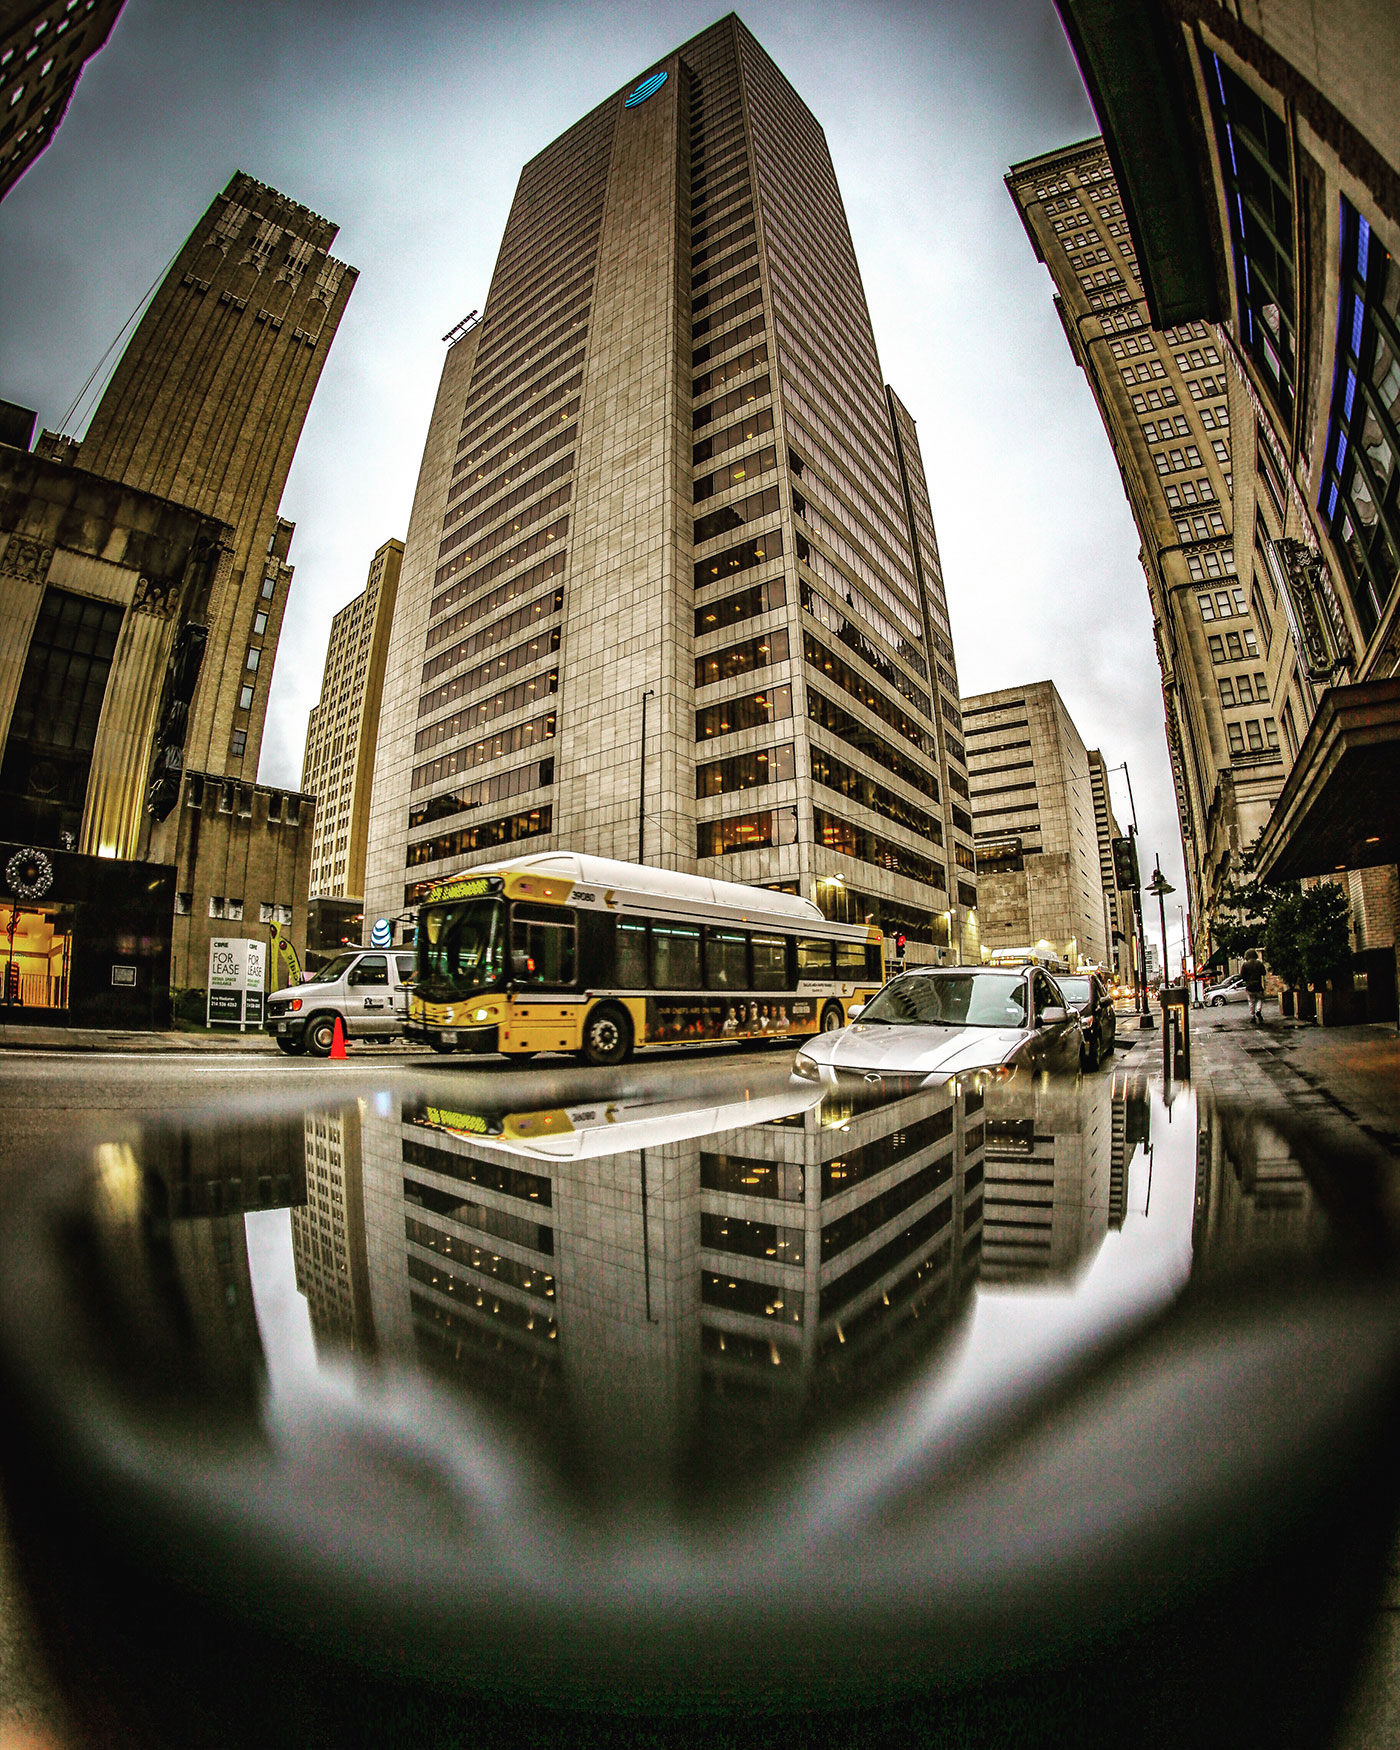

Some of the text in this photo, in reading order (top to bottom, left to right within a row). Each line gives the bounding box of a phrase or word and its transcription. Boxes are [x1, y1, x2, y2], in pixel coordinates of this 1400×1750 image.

[571, 891, 595, 902] 39080
[213, 953, 233, 963] FOR
[249, 954, 259, 965] FOR
[212, 964, 240, 975] LEASE
[248, 965, 262, 977] LEASE
